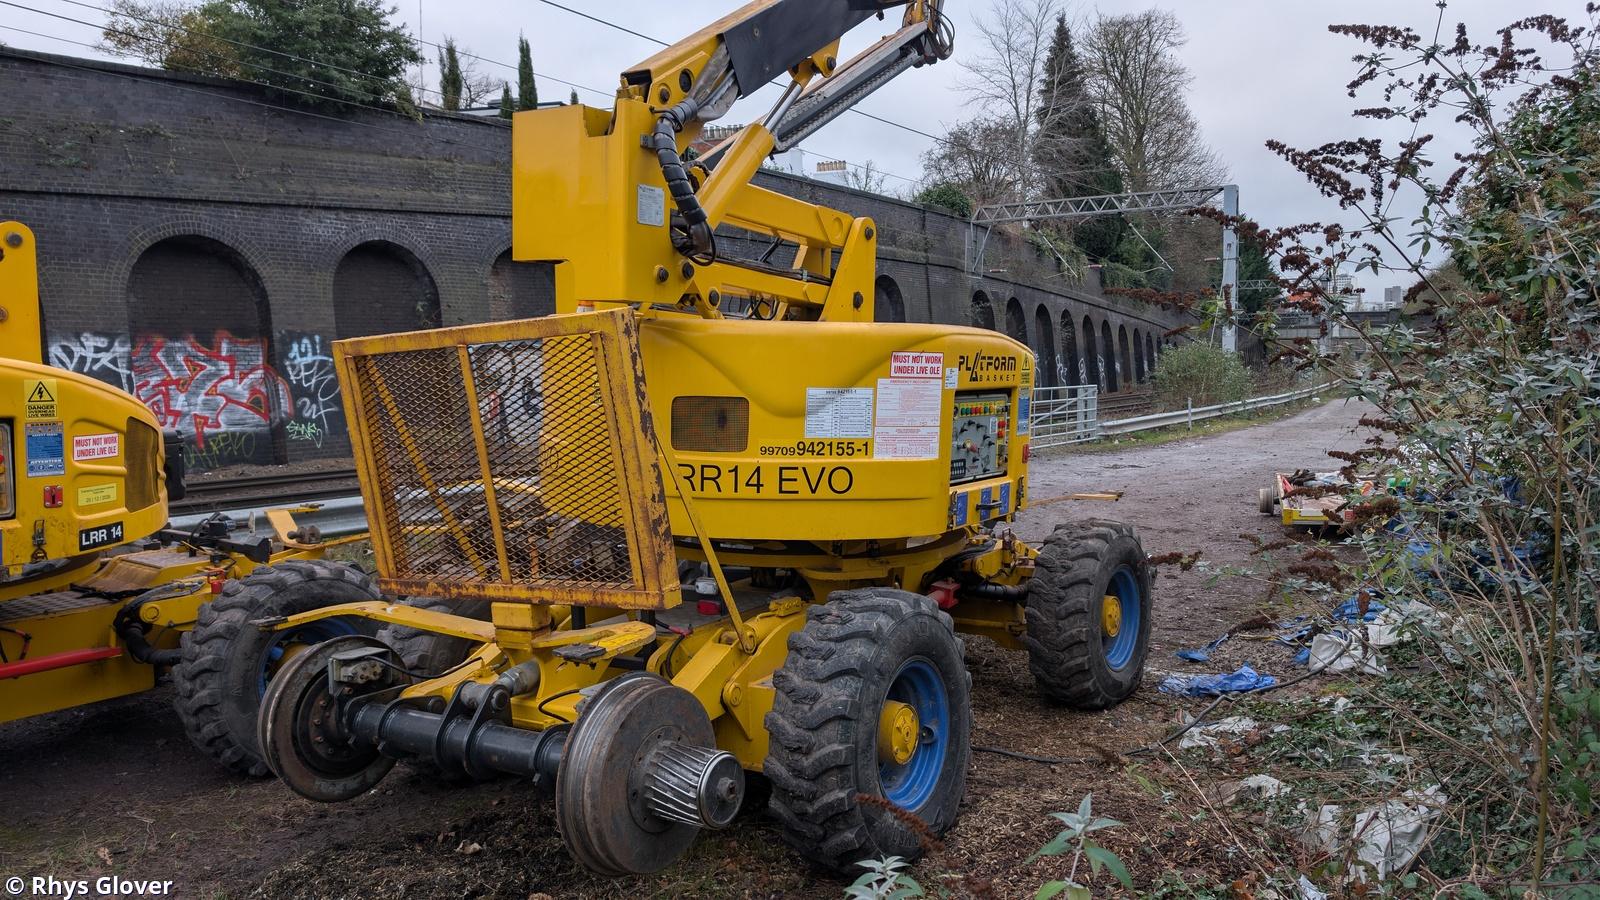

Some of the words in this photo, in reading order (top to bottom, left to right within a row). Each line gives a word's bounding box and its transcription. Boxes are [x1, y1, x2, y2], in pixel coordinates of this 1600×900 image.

[893, 354, 911, 363] MUST
[912, 355, 924, 363] NOT
[925, 355, 942, 364] WORK
[894, 366, 915, 374] UNDER
[916, 366, 928, 374] LIVE
[930, 366, 940, 375] OLE
[958, 349, 1016, 381] PLATFORM
[75, 438, 91, 447] MUST
[92, 438, 102, 446] NOT
[104, 436, 117, 445] WORK
[77, 448, 96, 457] UNDER
[97, 447, 107, 455] LIVE
[108, 446, 116, 454] OLE
[779, 466, 854, 495] EVO
[82, 528, 107, 546] LRR
[111, 525, 122, 539] 14
